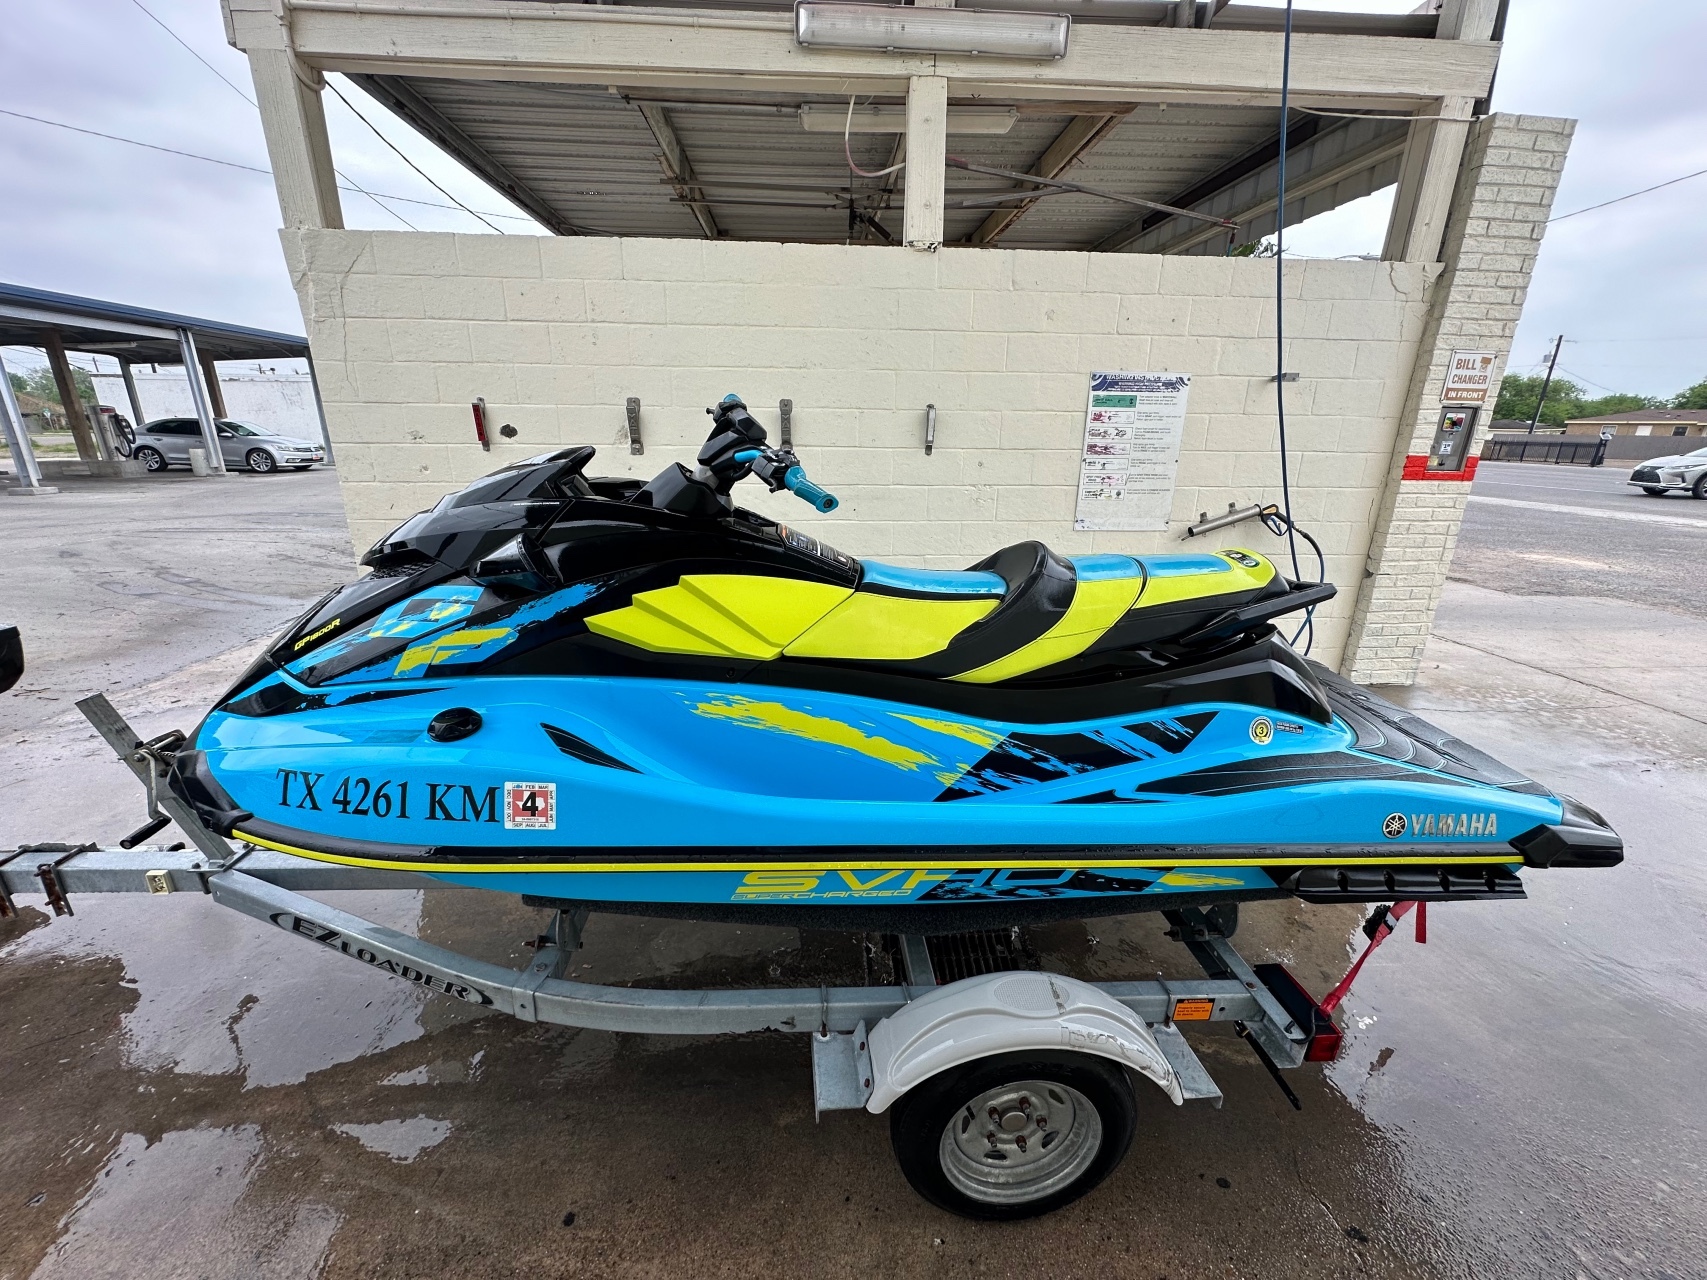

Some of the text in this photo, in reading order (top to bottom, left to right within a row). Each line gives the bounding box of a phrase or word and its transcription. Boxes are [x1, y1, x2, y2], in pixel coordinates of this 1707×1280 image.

[1455, 358, 1477, 370] BILL
[1451, 373, 1488, 385] CHANGER
[1448, 391, 1457, 399] IN
[293, 618, 341, 651] GP1800R
[276, 768, 501, 822] TX 4261 KM
[522, 791, 539, 817] 4
[1411, 813, 1497, 837] YAMAHA
[731, 889, 913, 900] SUPERCHARGED
